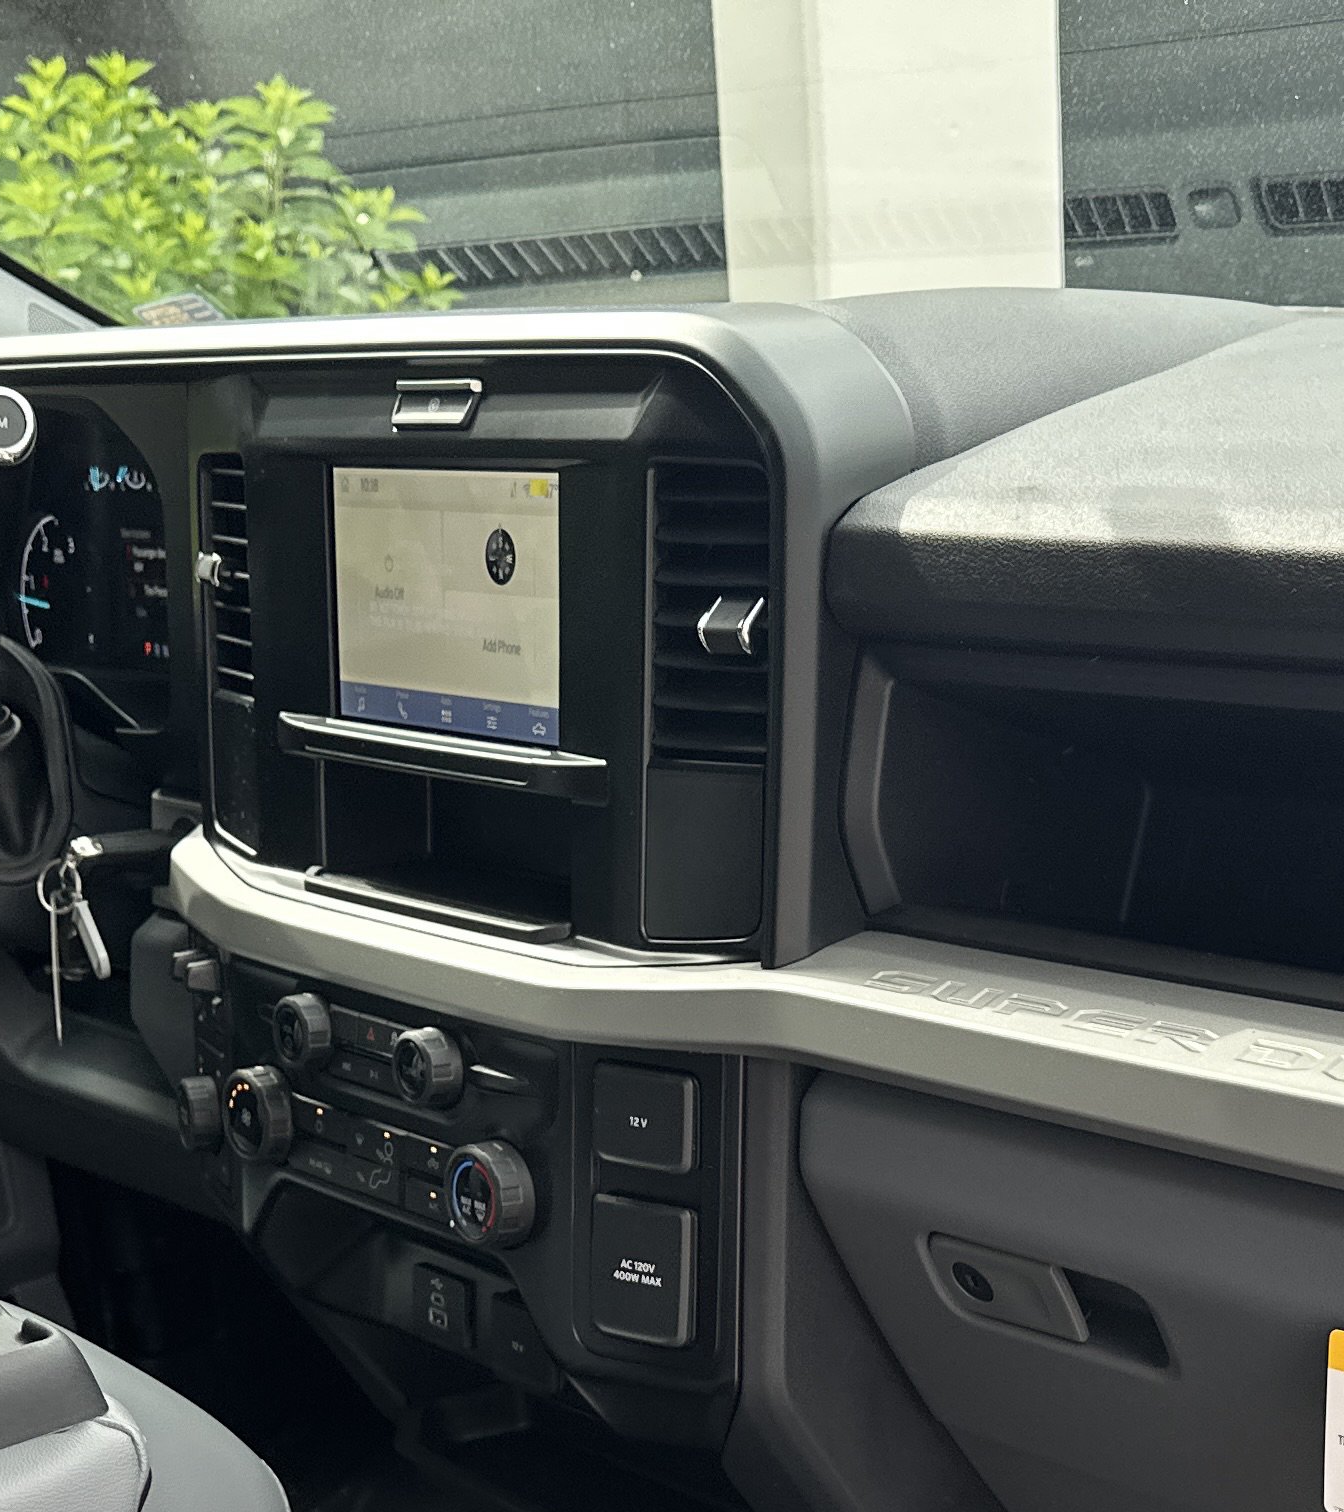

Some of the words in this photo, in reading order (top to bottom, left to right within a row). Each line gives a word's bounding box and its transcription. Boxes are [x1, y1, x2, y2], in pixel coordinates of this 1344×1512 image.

[483, 637, 497, 653] Add
[498, 640, 521, 656] Phone
[863, 970, 1221, 1053] SUPER
[620, 1259, 632, 1271] AC
[634, 1261, 656, 1274] 120V
[613, 1269, 640, 1284] 400W
[641, 1273, 662, 1287] MAX
